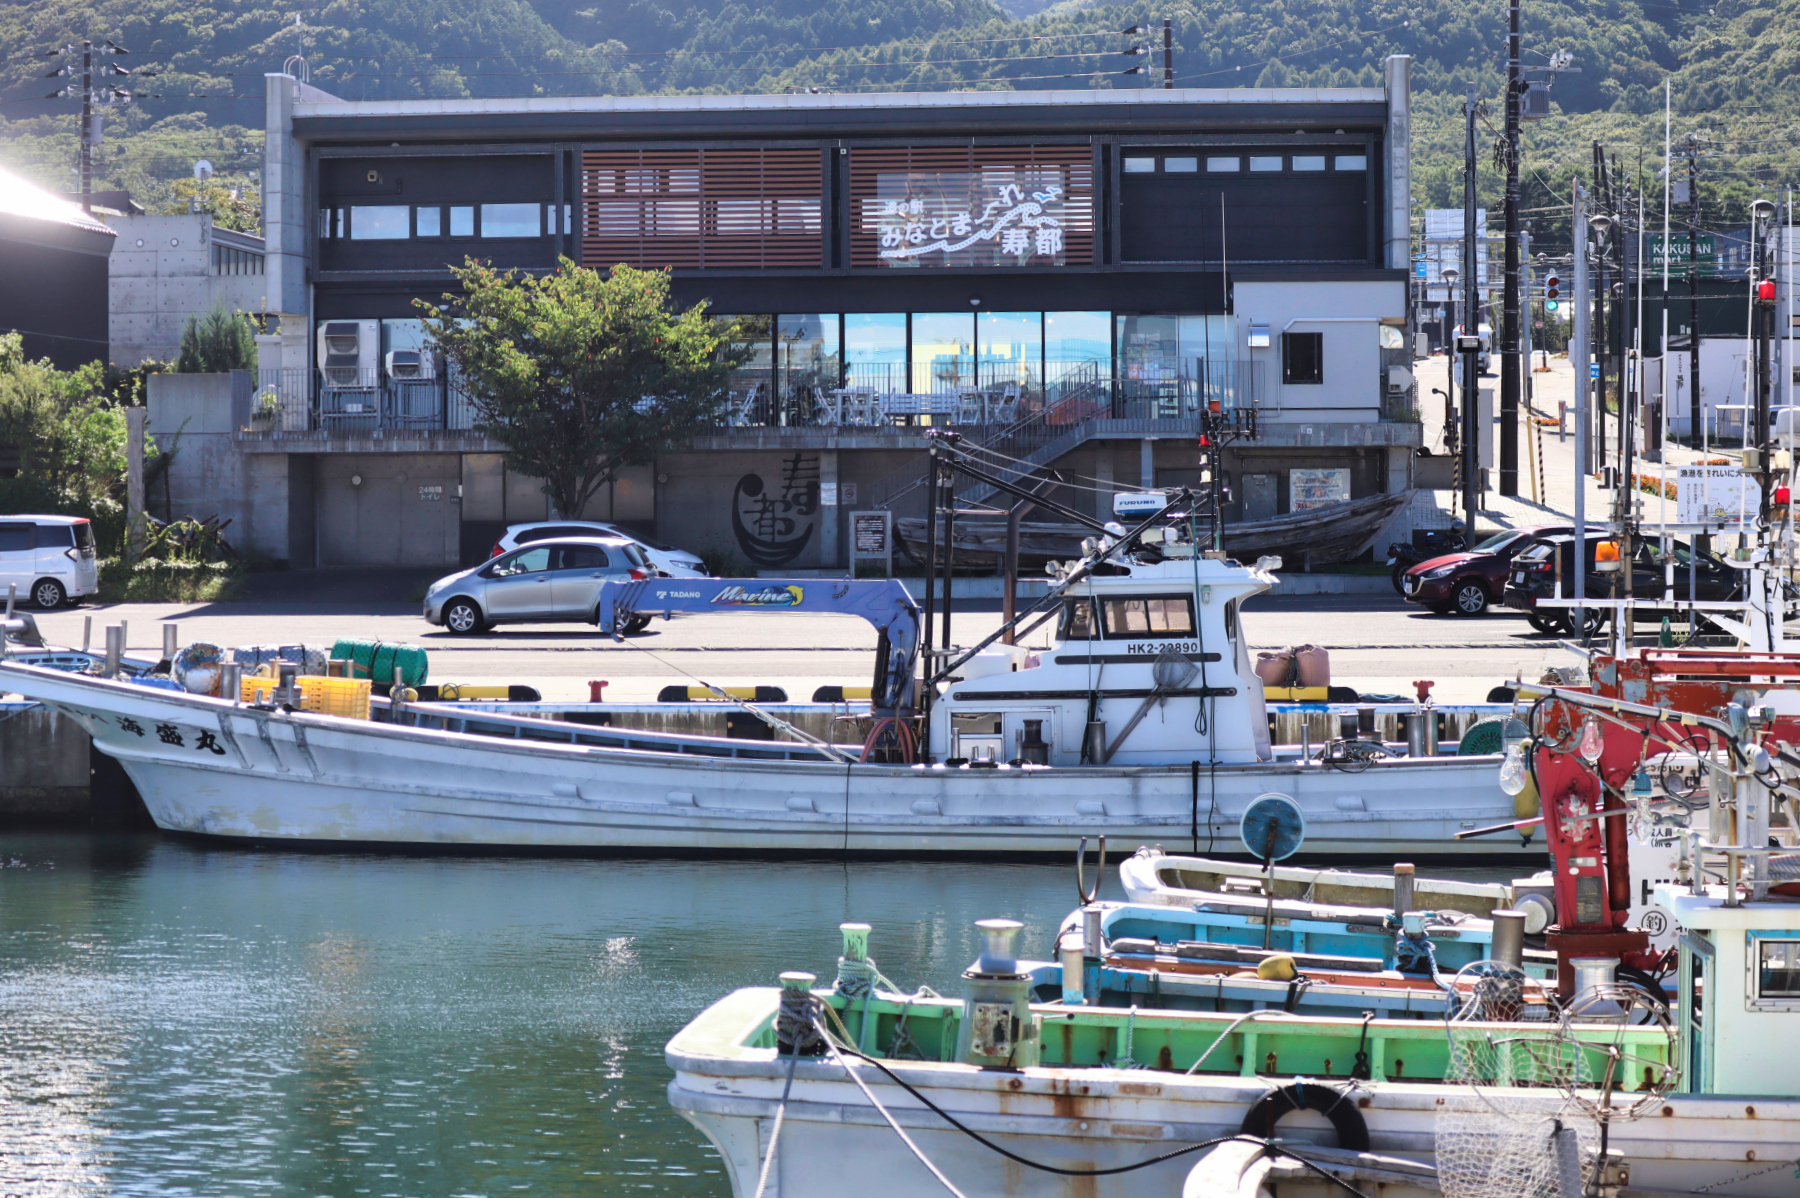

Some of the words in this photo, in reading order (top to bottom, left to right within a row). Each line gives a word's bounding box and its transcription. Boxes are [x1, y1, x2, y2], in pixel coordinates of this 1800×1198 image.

[884, 199, 924, 214] 道の駅
[1002, 228, 1063, 256] 寿都
[710, 586, 791, 604] Marine
